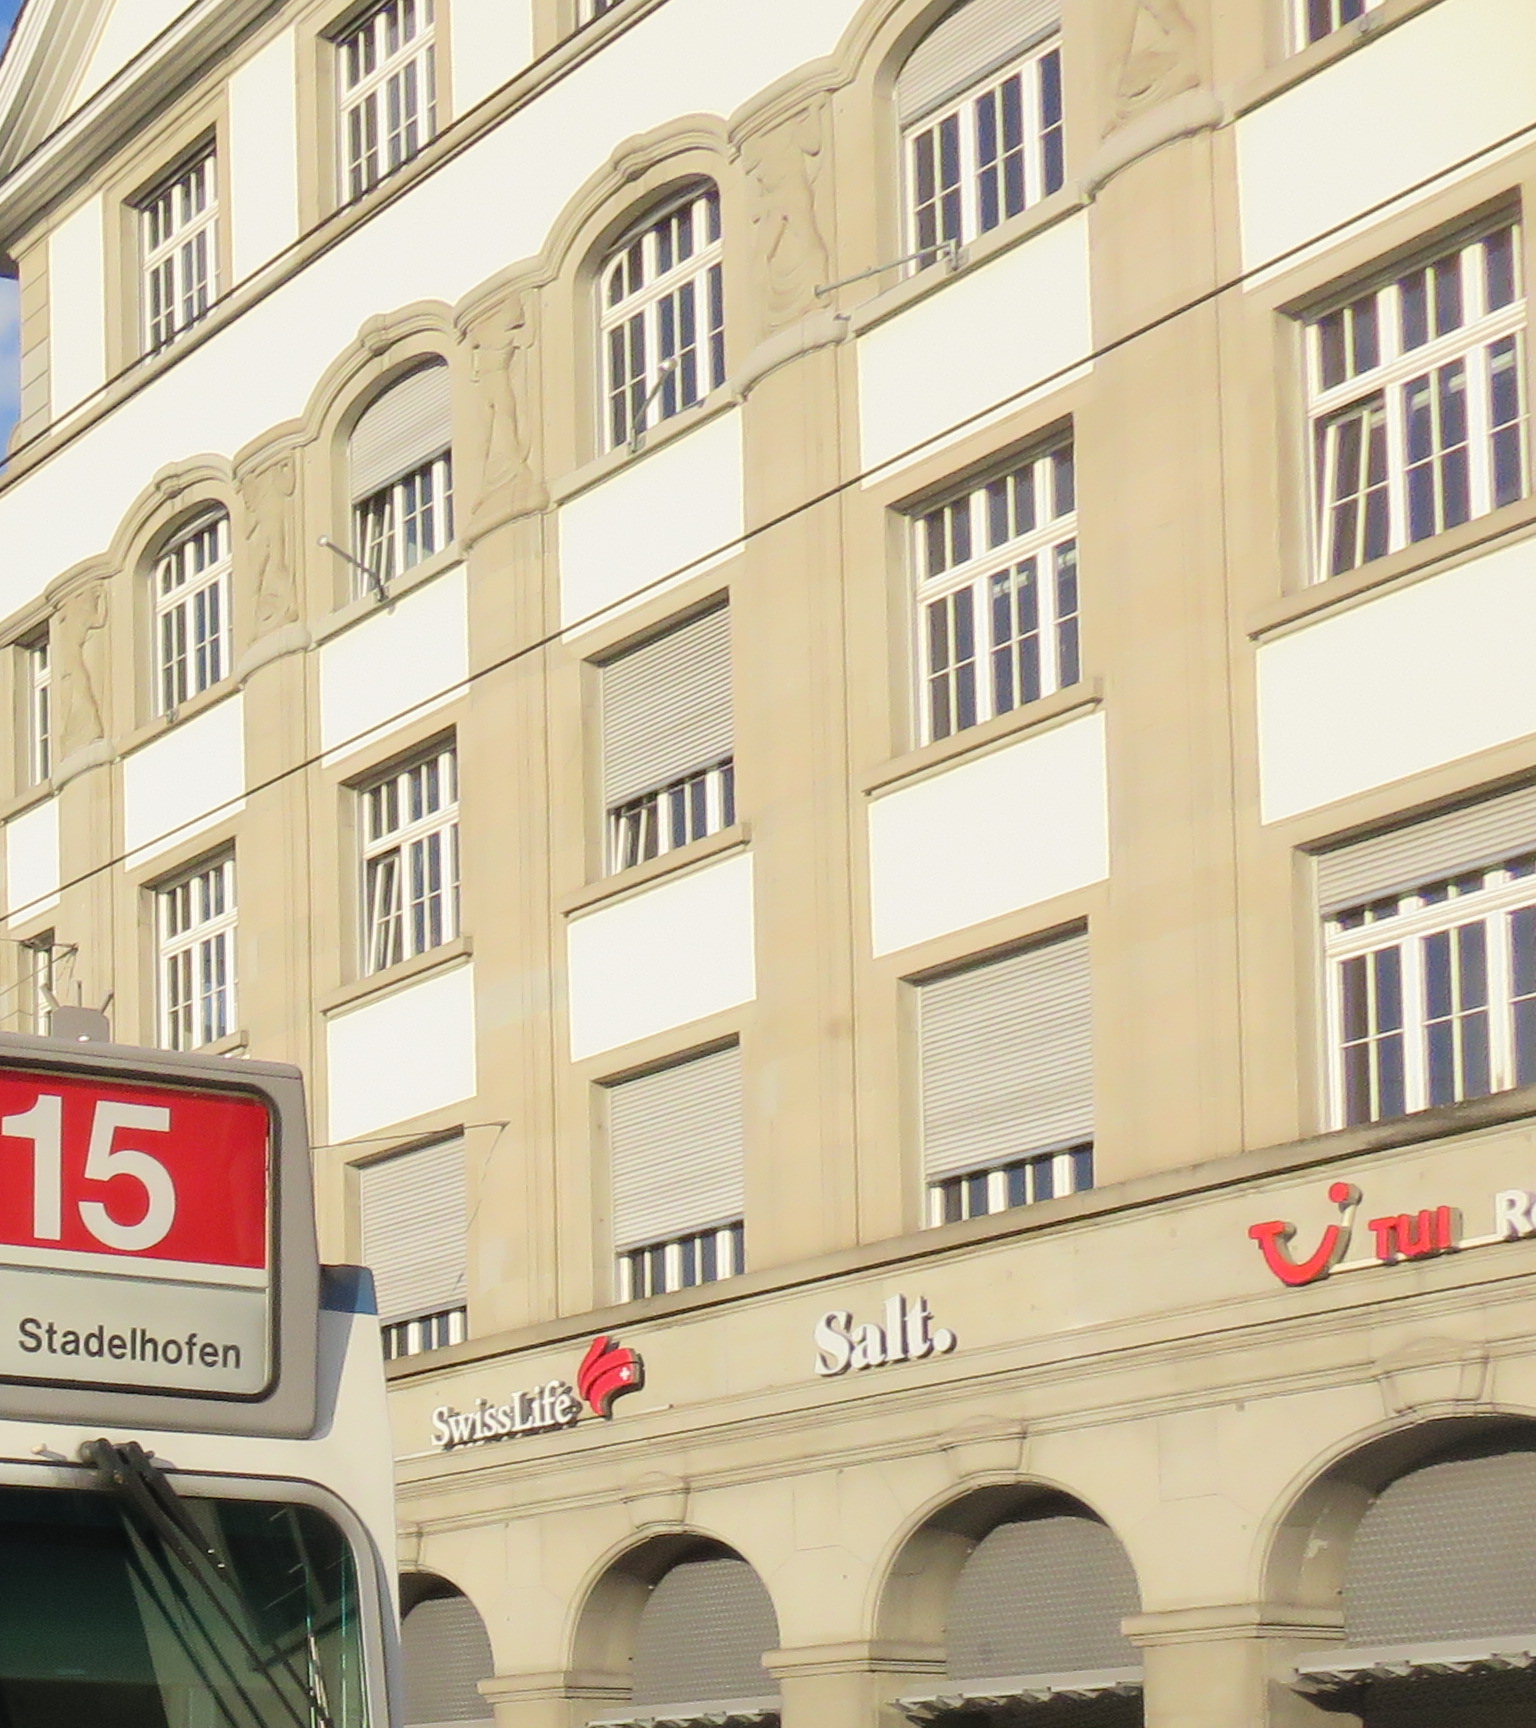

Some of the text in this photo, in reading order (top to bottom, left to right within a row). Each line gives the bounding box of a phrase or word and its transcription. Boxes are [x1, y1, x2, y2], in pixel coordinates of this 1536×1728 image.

[1, 1094, 176, 1251] 15
[1368, 1189, 1536, 1260] TUI R
[18, 1318, 241, 1369] Stadelhofen
[813, 1293, 955, 1376] Salt.
[431, 1380, 573, 1446] SwissLife
